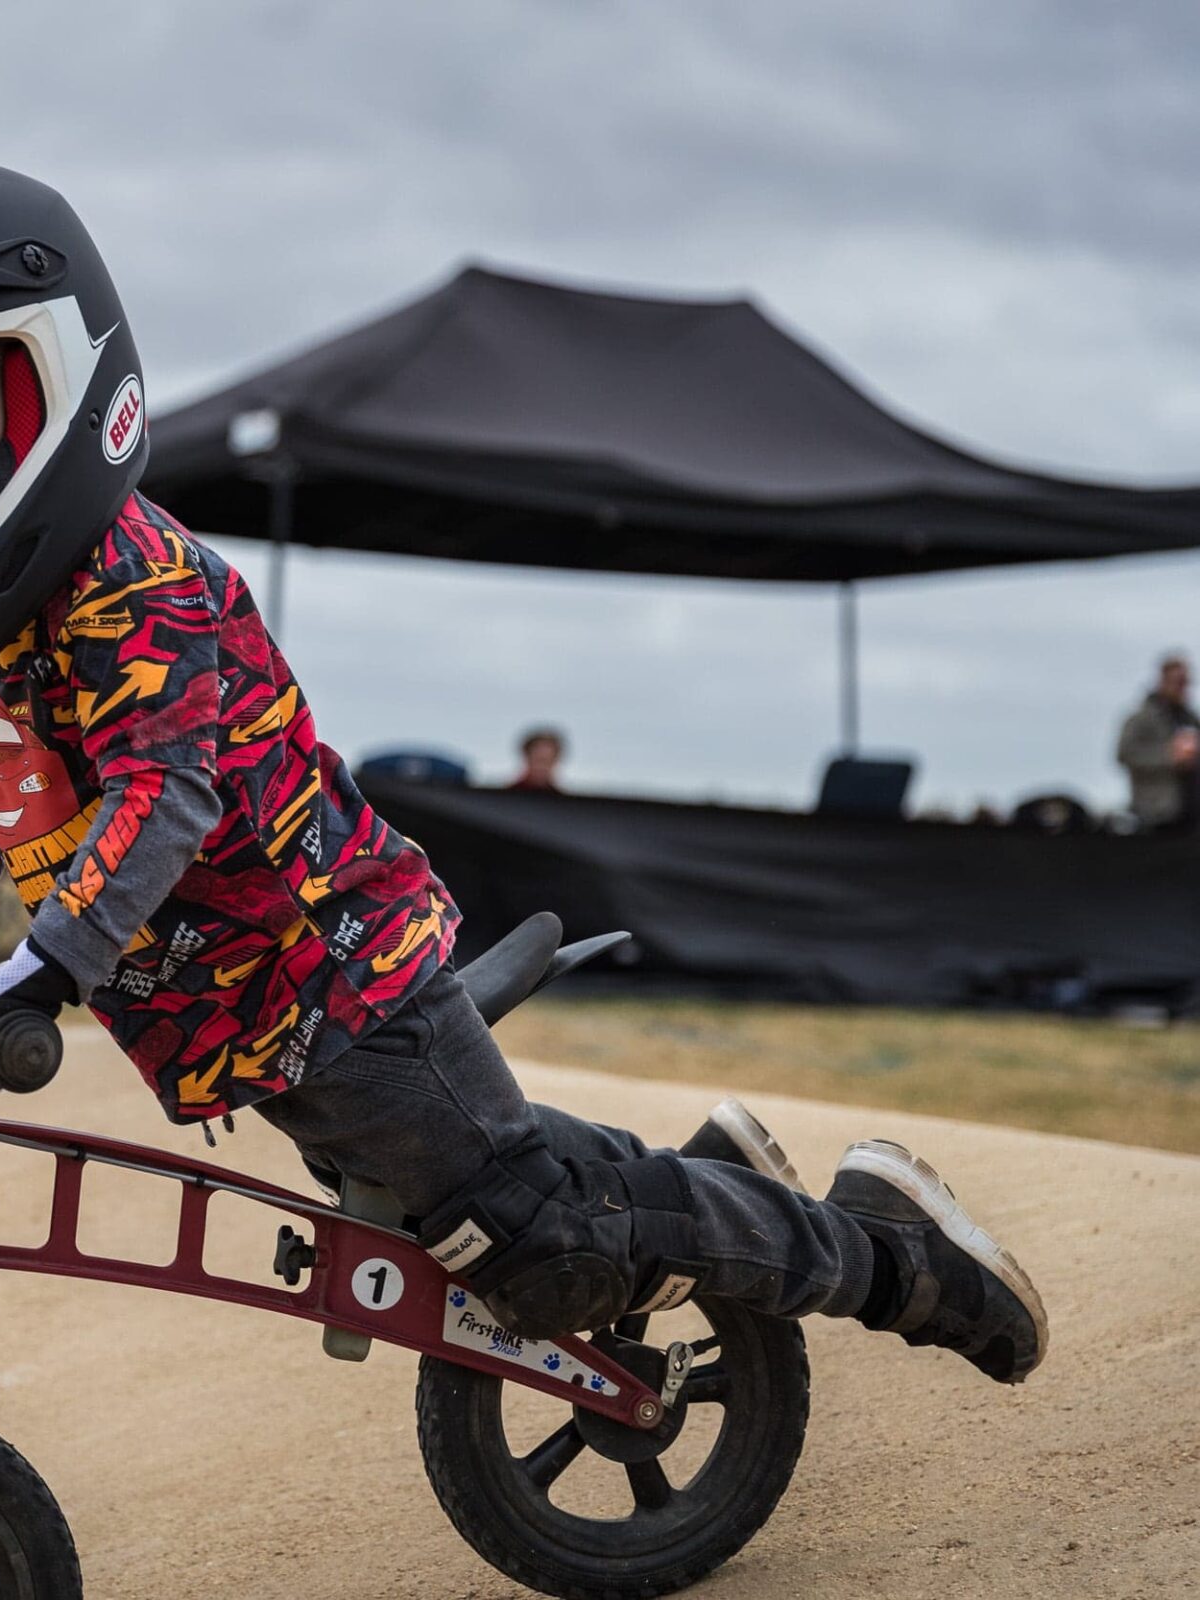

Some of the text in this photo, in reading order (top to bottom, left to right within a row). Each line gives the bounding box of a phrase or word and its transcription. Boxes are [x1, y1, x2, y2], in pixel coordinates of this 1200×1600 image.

[108, 387, 141, 452] BELL
[171, 595, 204, 606] MACH
[116, 968, 158, 998] PASS
[157, 956, 183, 982] SHIFT
[295, 1006, 324, 1047] SHIFT
[367, 1265, 389, 1305] 1
